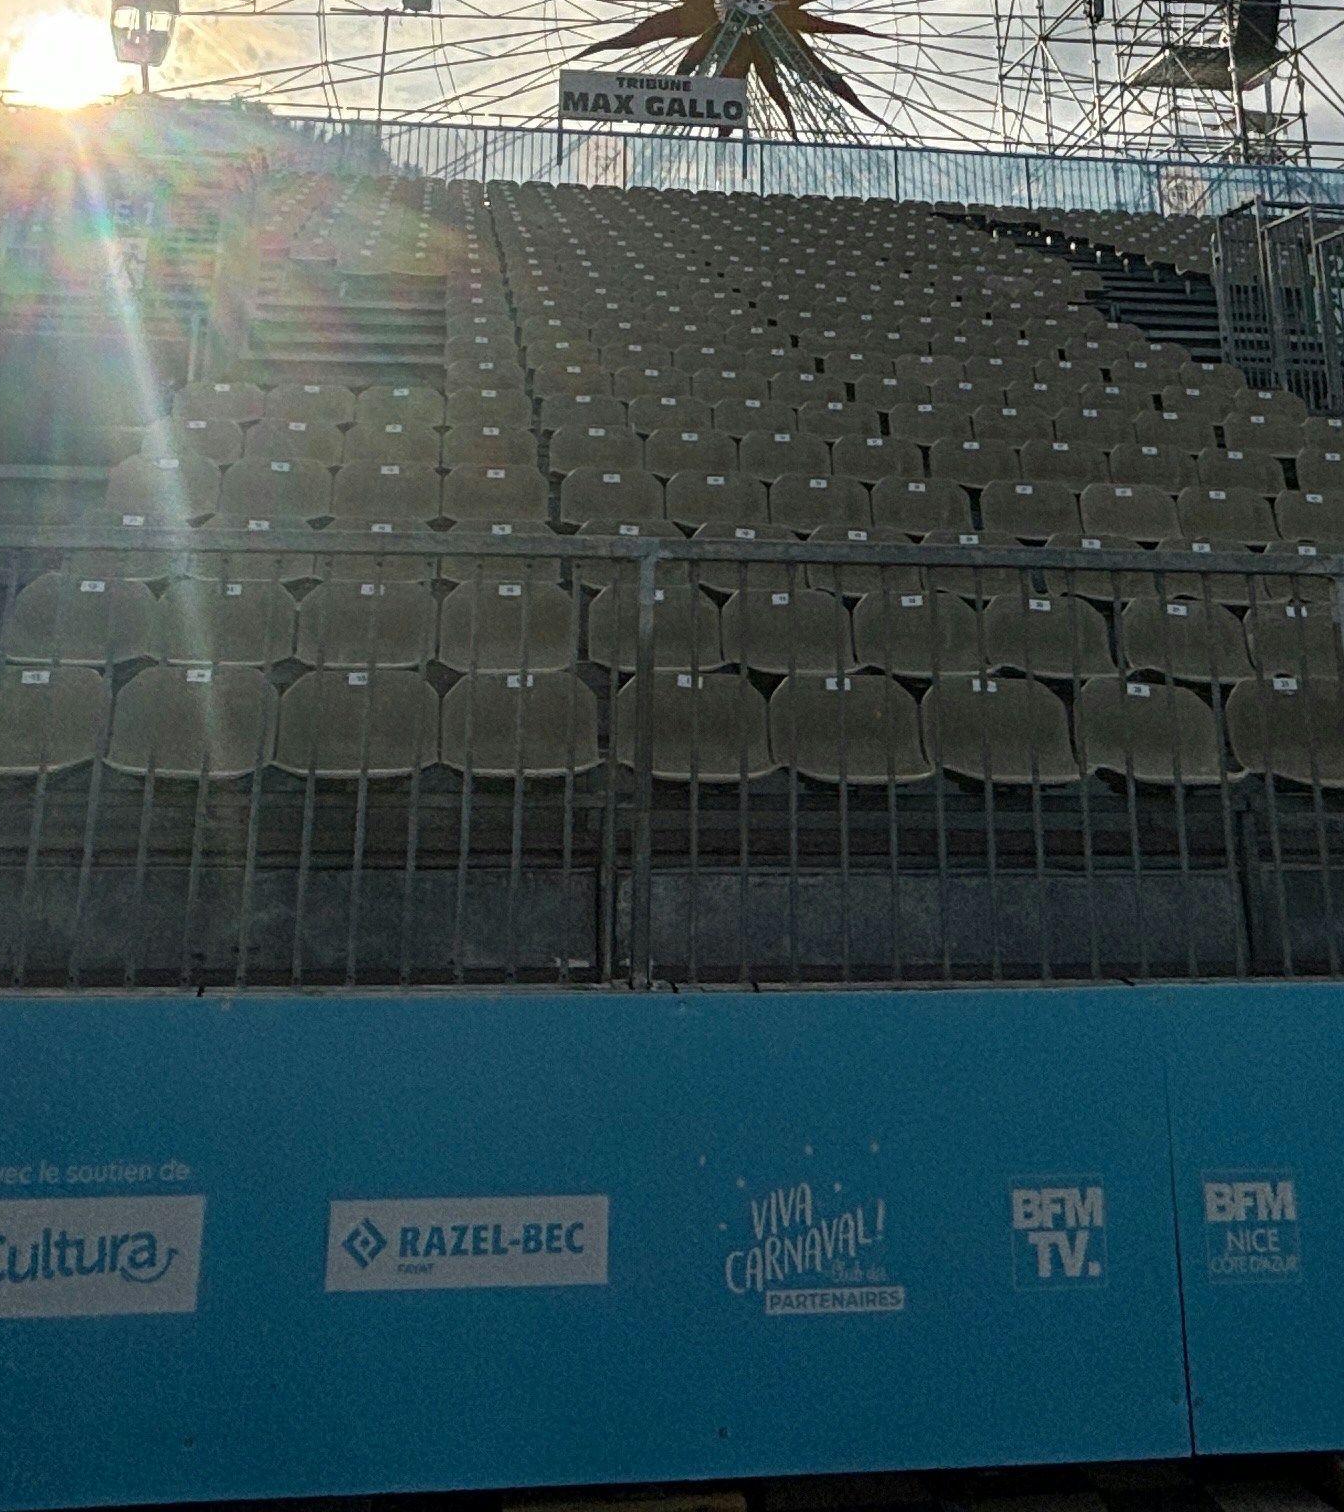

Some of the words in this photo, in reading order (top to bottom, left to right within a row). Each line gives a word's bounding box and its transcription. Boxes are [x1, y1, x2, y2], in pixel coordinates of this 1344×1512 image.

[615, 76, 693, 92] TRIBUNE
[562, 91, 634, 115] MAX
[645, 96, 744, 120] GALLO
[39, 1160, 60, 1183] le
[66, 1160, 153, 1184] soutien
[158, 1158, 191, 1182] de
[750, 1181, 813, 1241] VIVA
[1012, 1186, 1104, 1229] BFM
[1203, 1180, 1297, 1222] BFM
[397, 1221, 585, 1258] RAZEL-BEC
[1028, 1230, 1102, 1278] TV.
[1226, 1228, 1281, 1253] NICE
[768, 1289, 902, 1312] PARTENAIRES
